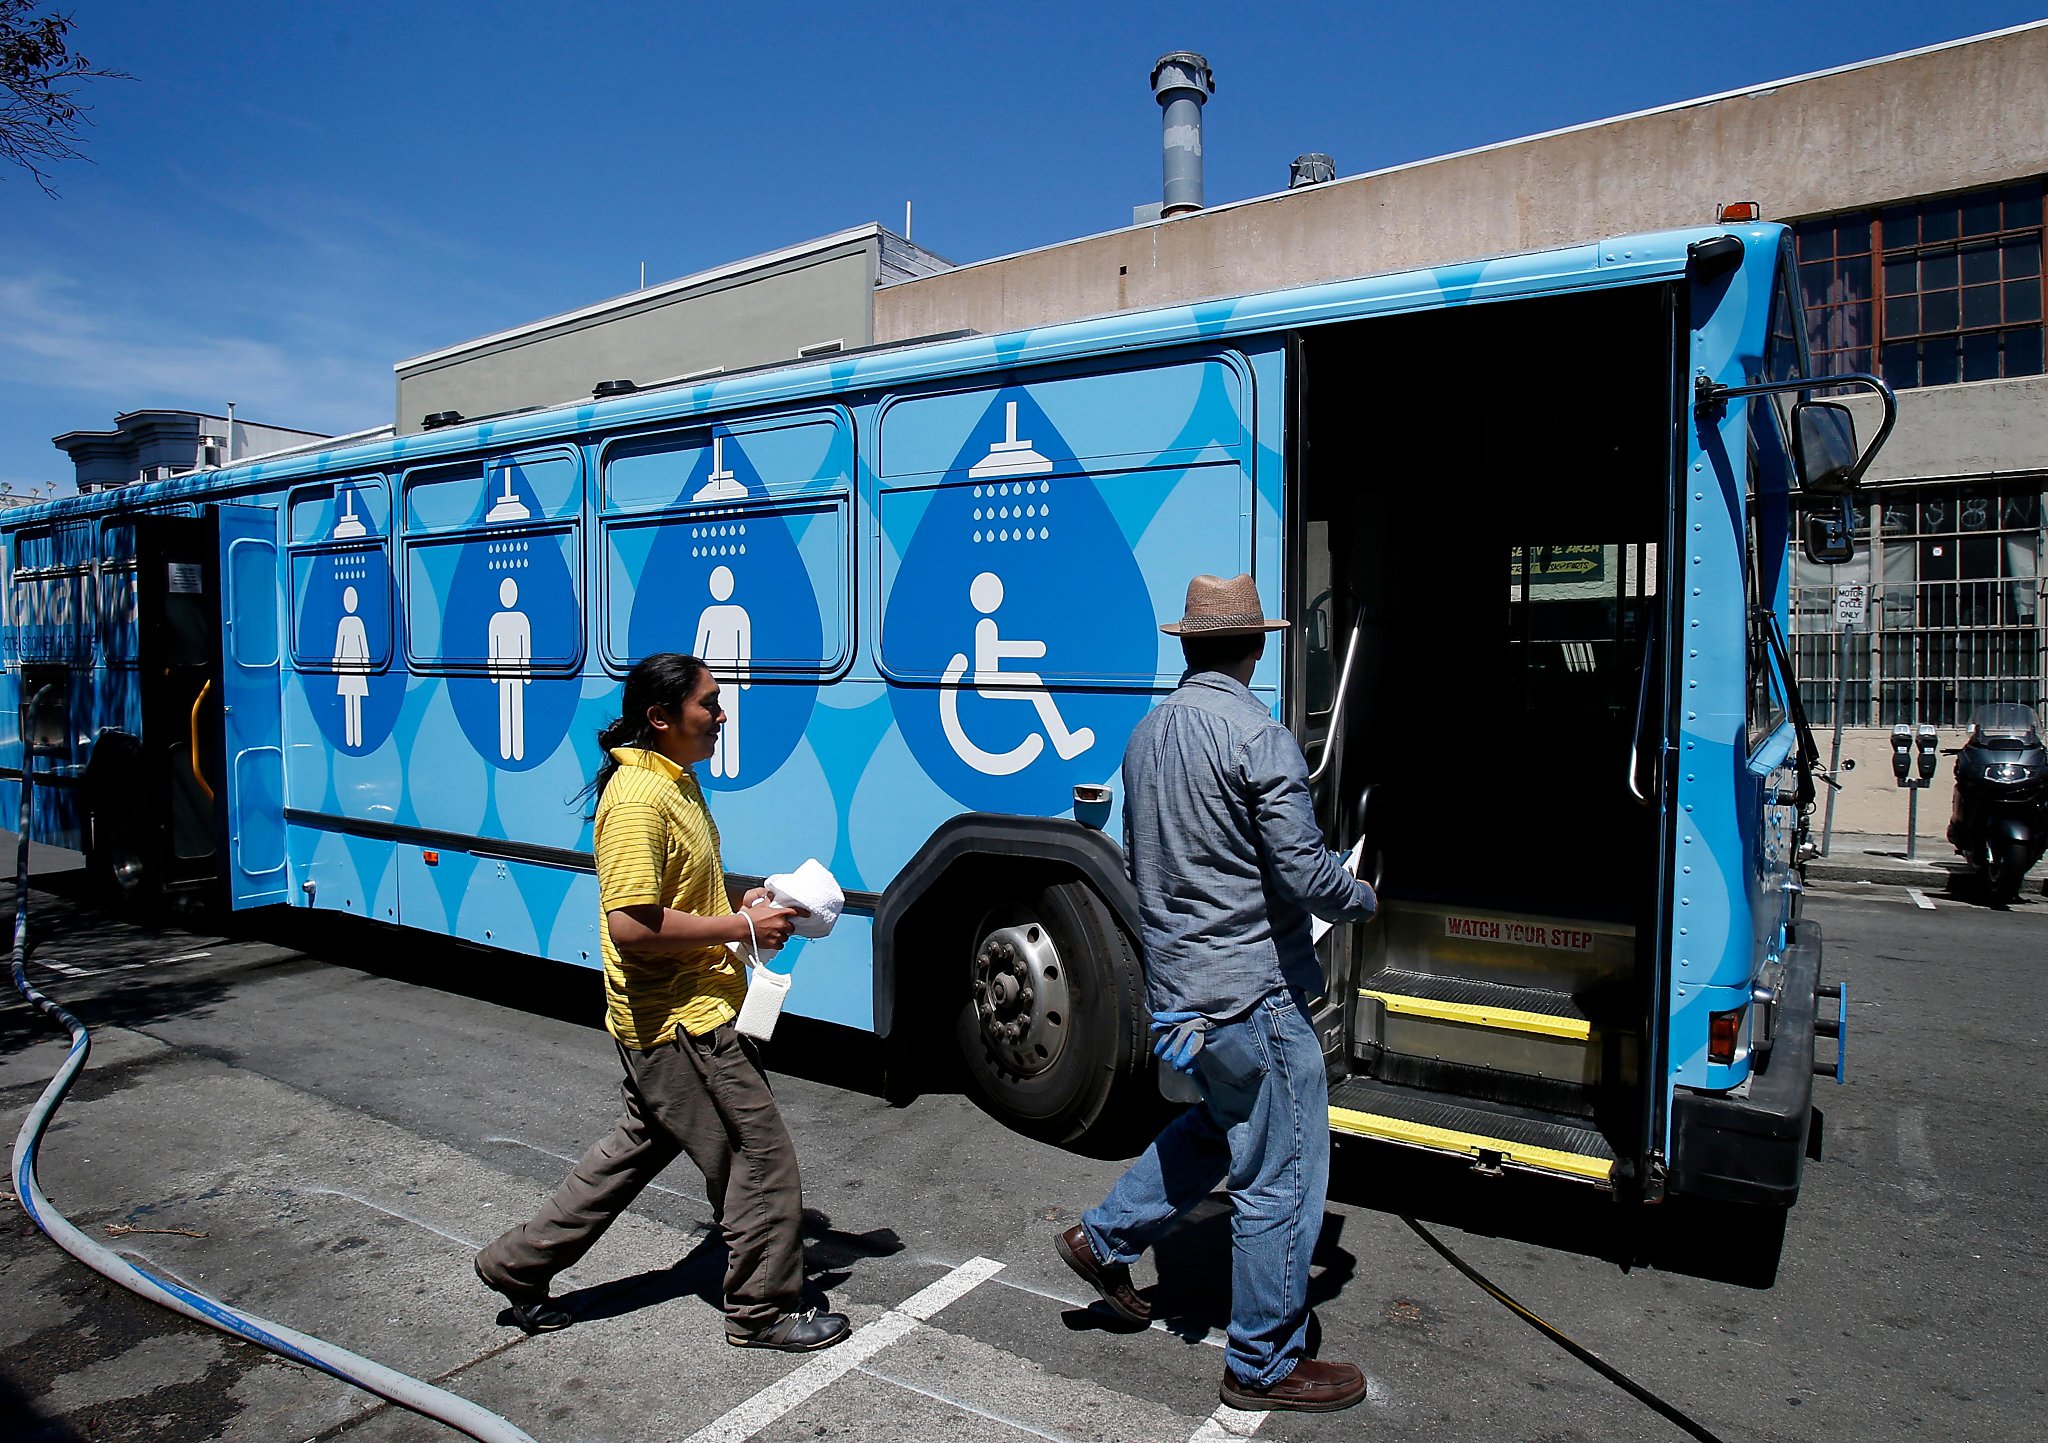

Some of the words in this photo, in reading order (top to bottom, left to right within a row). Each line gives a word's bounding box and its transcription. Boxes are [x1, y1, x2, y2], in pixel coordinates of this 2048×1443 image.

[1839, 600, 1863, 609] CYCLE
[1840, 611, 1860, 619] ONLY
[1447, 917, 1500, 939] WATCH
[1504, 923, 1546, 944] YOUR
[1551, 928, 1593, 949] STEP
